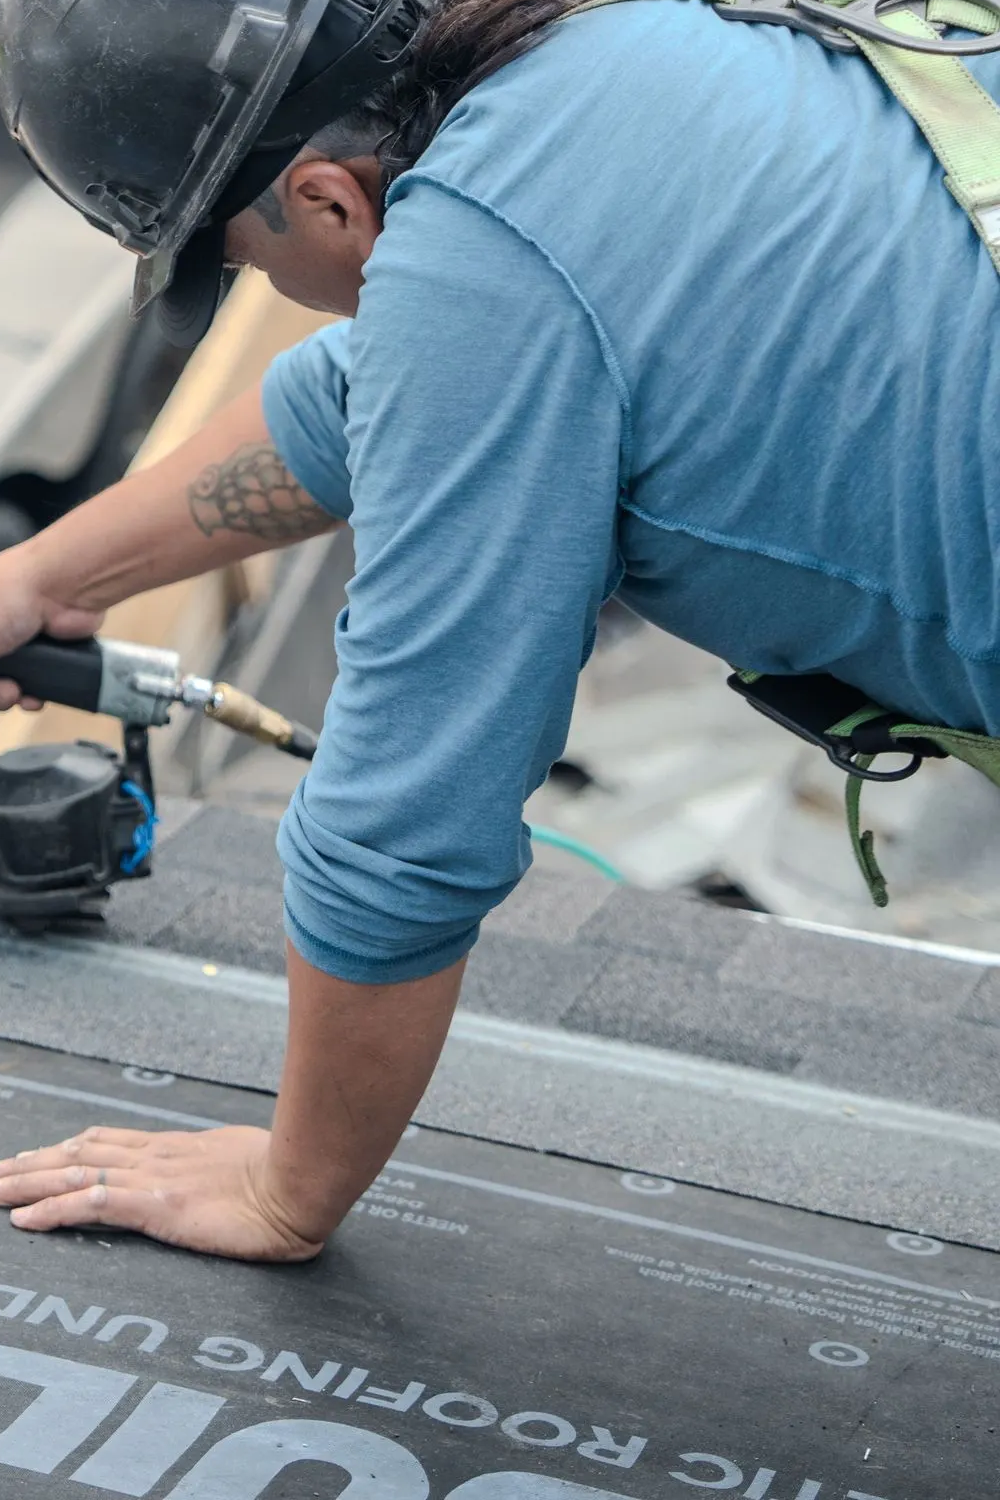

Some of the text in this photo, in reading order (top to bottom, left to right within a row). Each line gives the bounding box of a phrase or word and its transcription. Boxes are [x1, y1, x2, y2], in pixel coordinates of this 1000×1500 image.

[368, 1204, 400, 1219] OR
[401, 1211, 470, 1236] MEETS
[638, 1265, 685, 1285] pitch
[685, 1276, 725, 1293] roof
[728, 1286, 763, 1302] and
[764, 1296, 846, 1325] footwear
[191, 1335, 650, 1470] ROOFING
